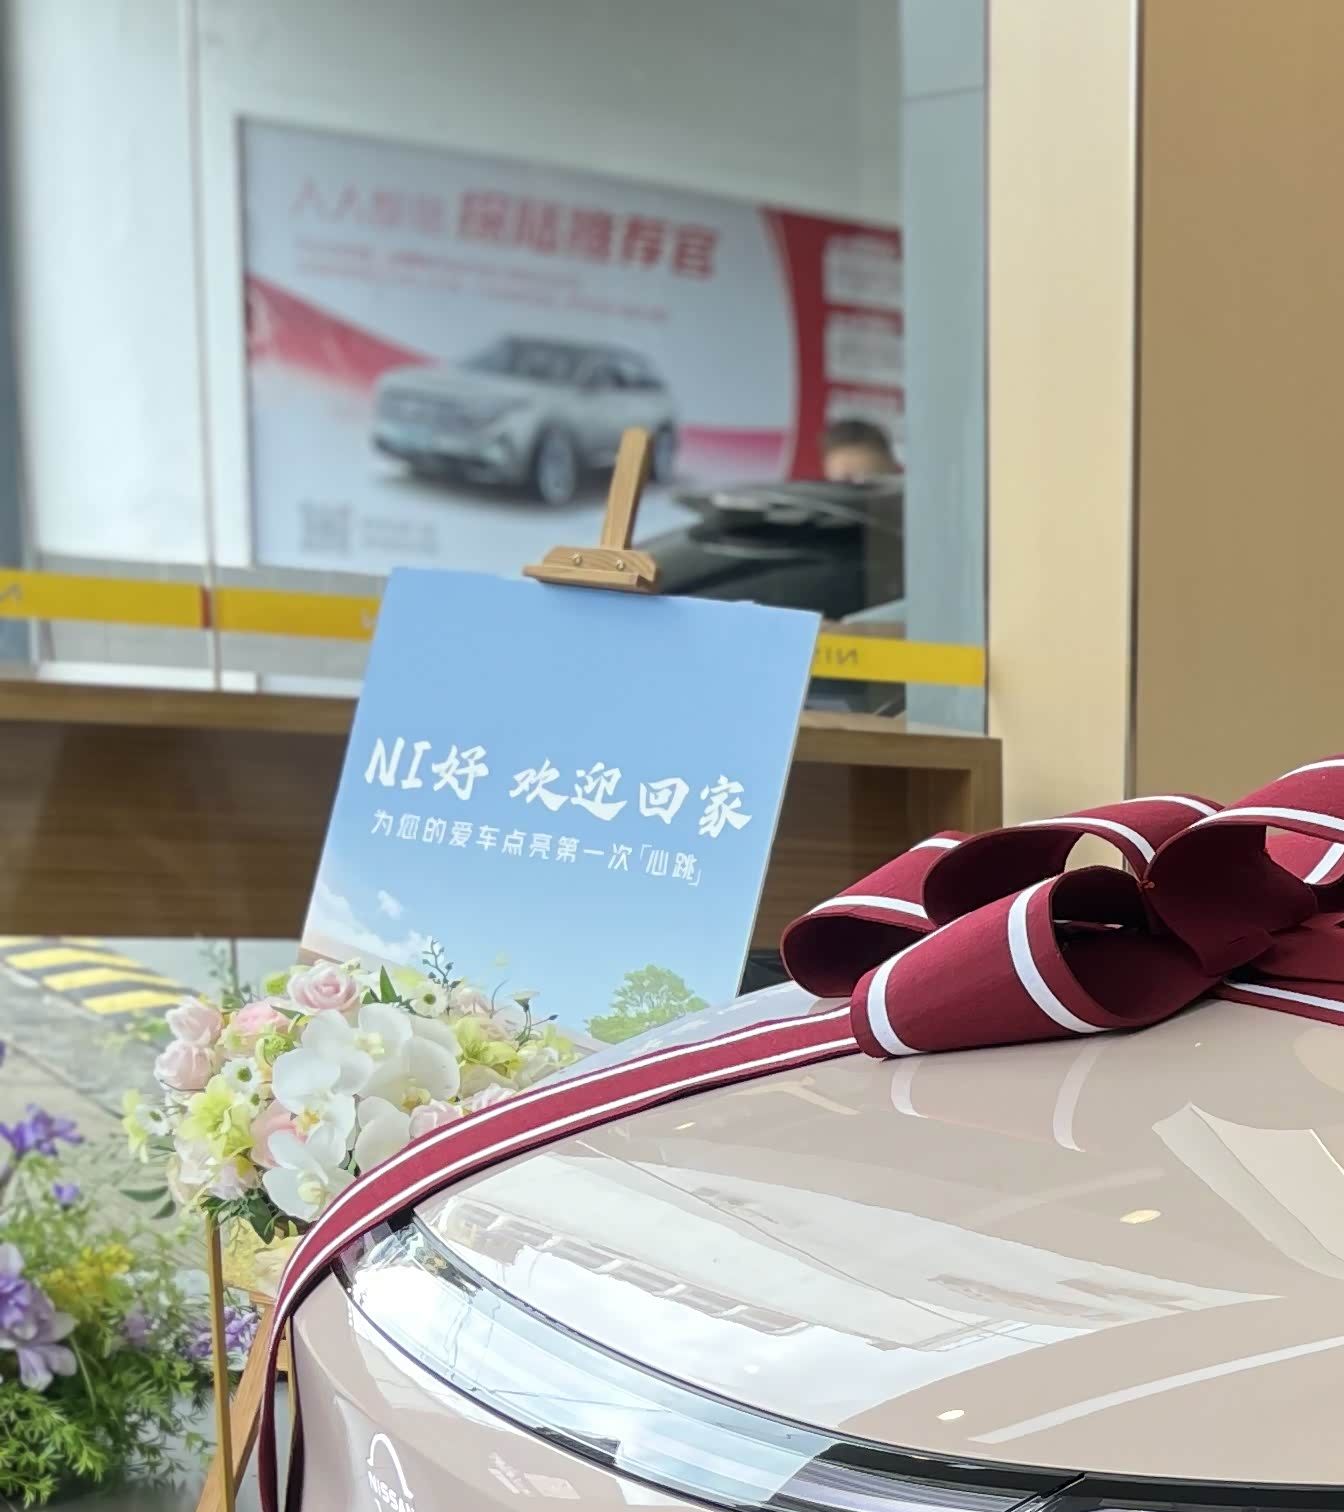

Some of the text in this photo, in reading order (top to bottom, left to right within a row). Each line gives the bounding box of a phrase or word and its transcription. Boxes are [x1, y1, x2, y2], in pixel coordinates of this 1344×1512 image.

[364, 736, 754, 839] NI好 欢迎回家
